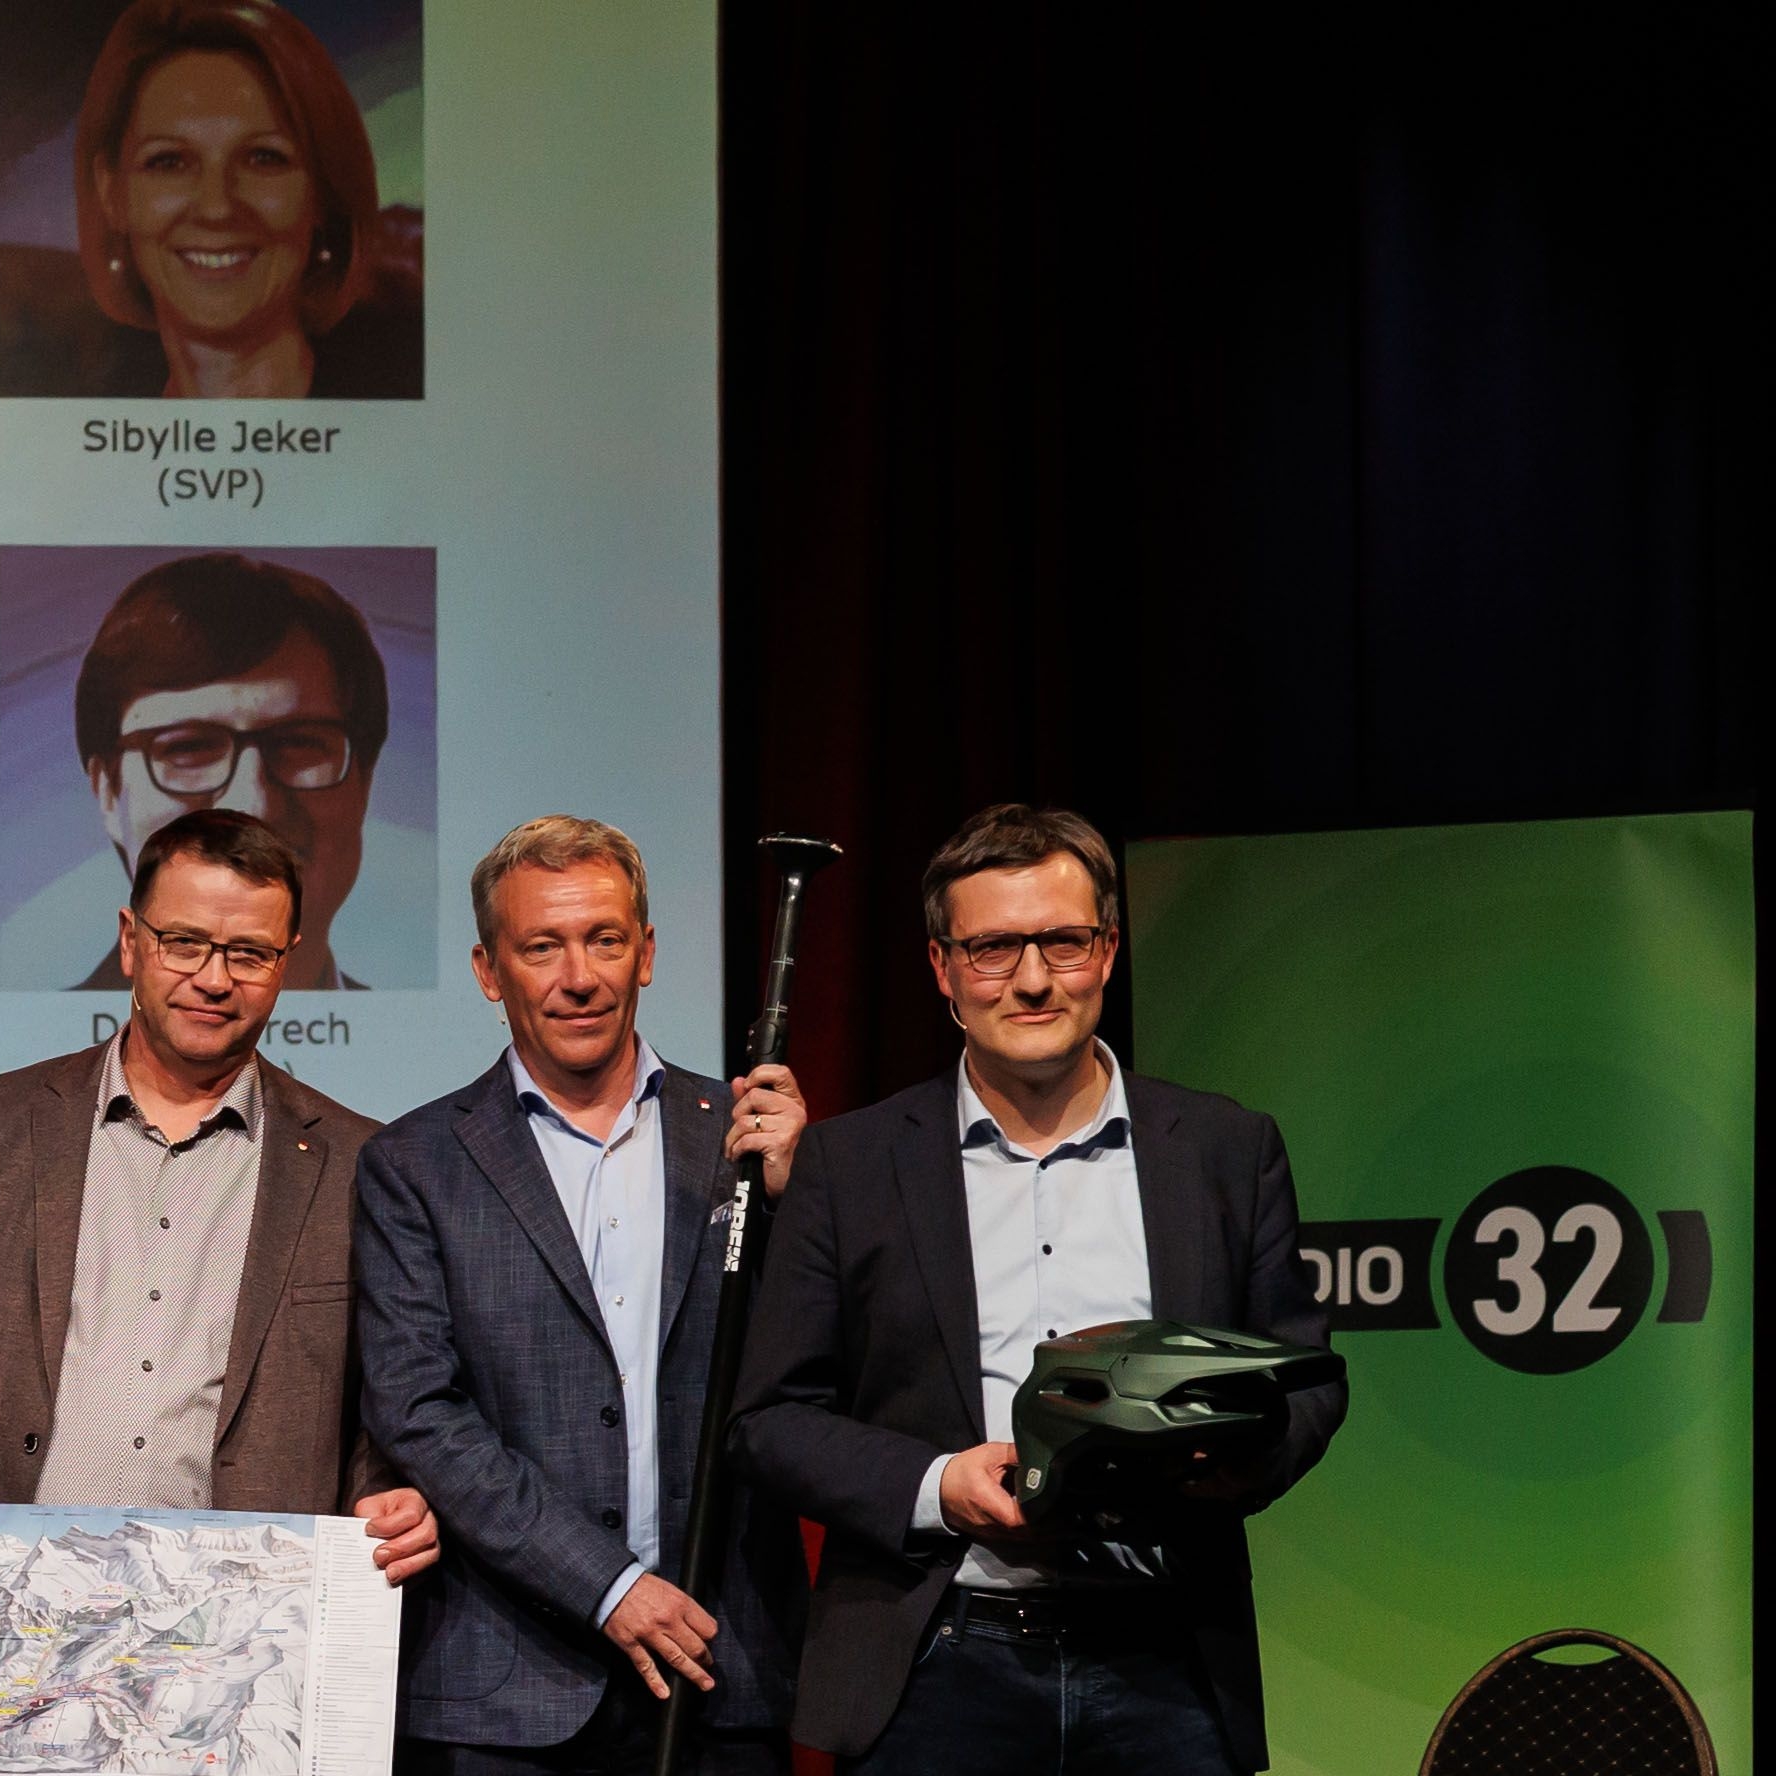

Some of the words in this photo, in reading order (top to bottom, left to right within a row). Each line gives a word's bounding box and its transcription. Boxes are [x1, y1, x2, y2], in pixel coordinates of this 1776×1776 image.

[84, 419, 216, 461] Sibylle
[231, 420, 341, 454] Jeker
[158, 468, 264, 508] (SVP)
[267, 1011, 350, 1044] rech
[1298, 1246, 1404, 1305] DIO
[1473, 1203, 1623, 1336] 32
